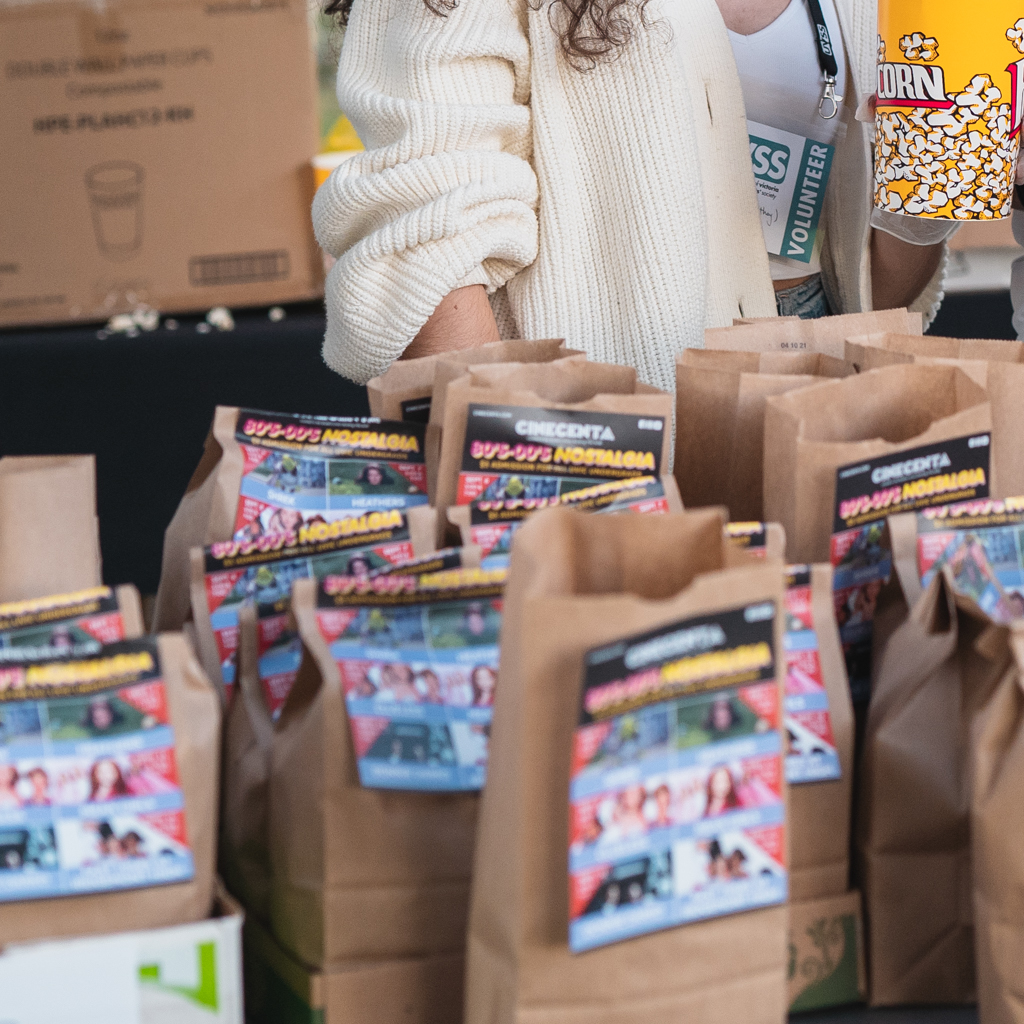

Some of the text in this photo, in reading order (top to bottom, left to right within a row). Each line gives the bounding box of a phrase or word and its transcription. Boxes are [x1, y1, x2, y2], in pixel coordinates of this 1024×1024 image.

[787, 144, 828, 255] VOLUNTEER
[321, 428, 420, 453] NOSTALGIA
[515, 419, 615, 441] CINECENTA
[554, 446, 656, 470] NOSTALGIA
[352, 497, 406, 508] HEATHERS
